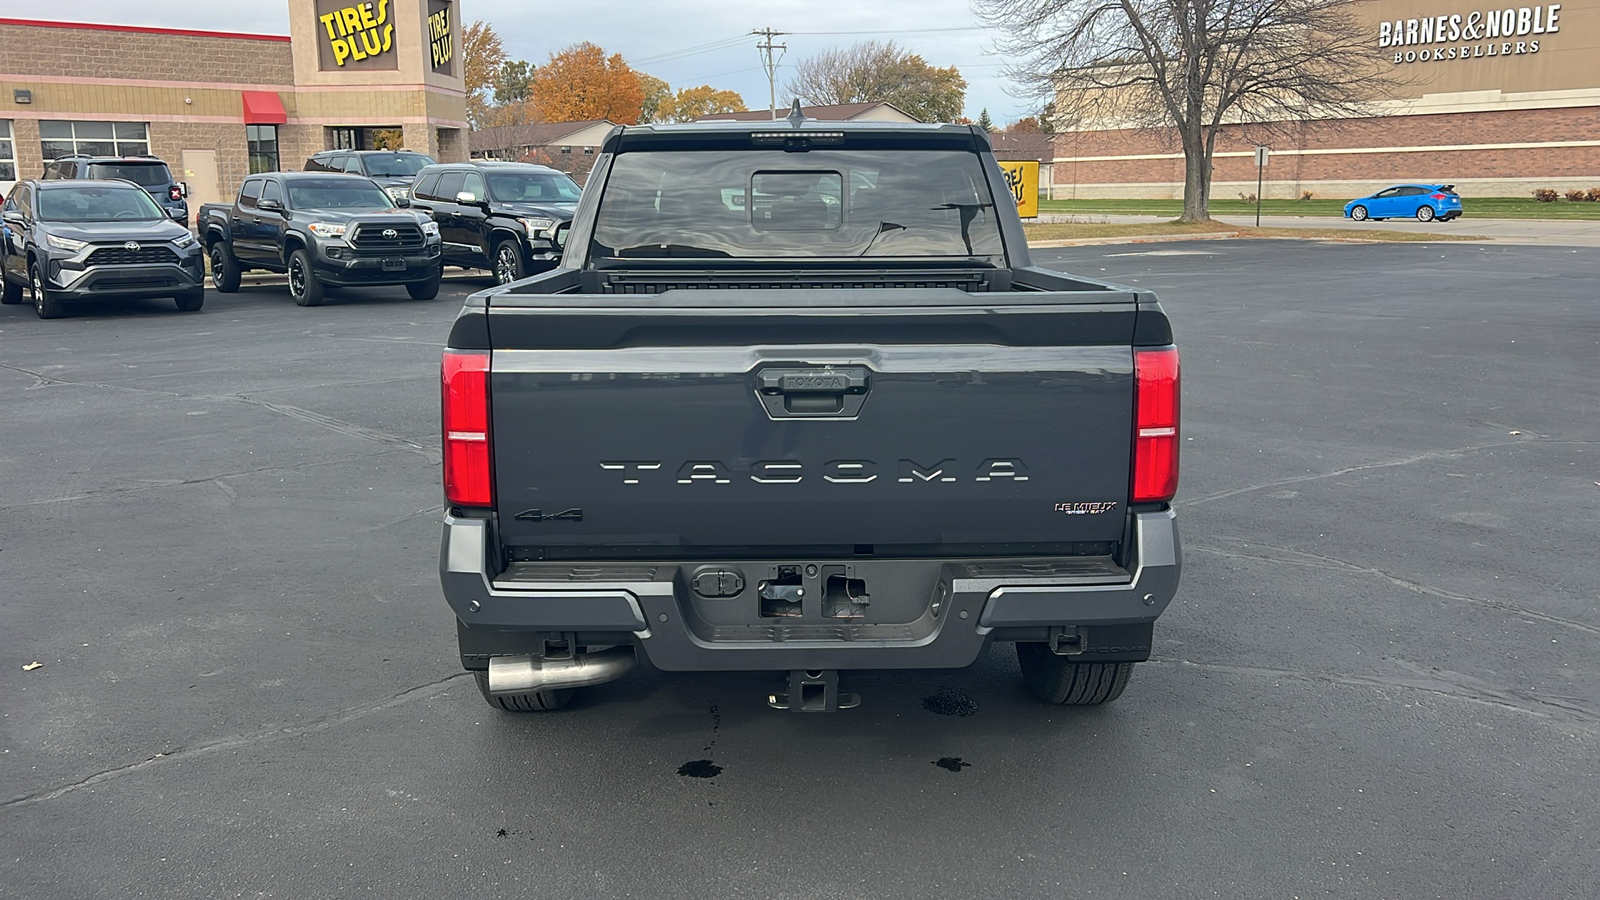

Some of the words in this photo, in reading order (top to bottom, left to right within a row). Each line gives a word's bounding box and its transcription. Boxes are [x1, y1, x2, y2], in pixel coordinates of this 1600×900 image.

[319, 0, 389, 41] TIRES
[428, 7, 450, 41] TIRES
[331, 23, 394, 66] PLUS
[431, 33, 453, 68] PLUS
[1394, 40, 1540, 64] BOOKSELLERS
[1001, 166, 1024, 189] RES
[786, 377, 843, 389] TOYOTA
[600, 457, 1030, 485] TACOMA
[1054, 502, 1072, 512] LE
[1073, 501, 1118, 511] MIEUX
[1086, 645, 1149, 654] ACOMA
